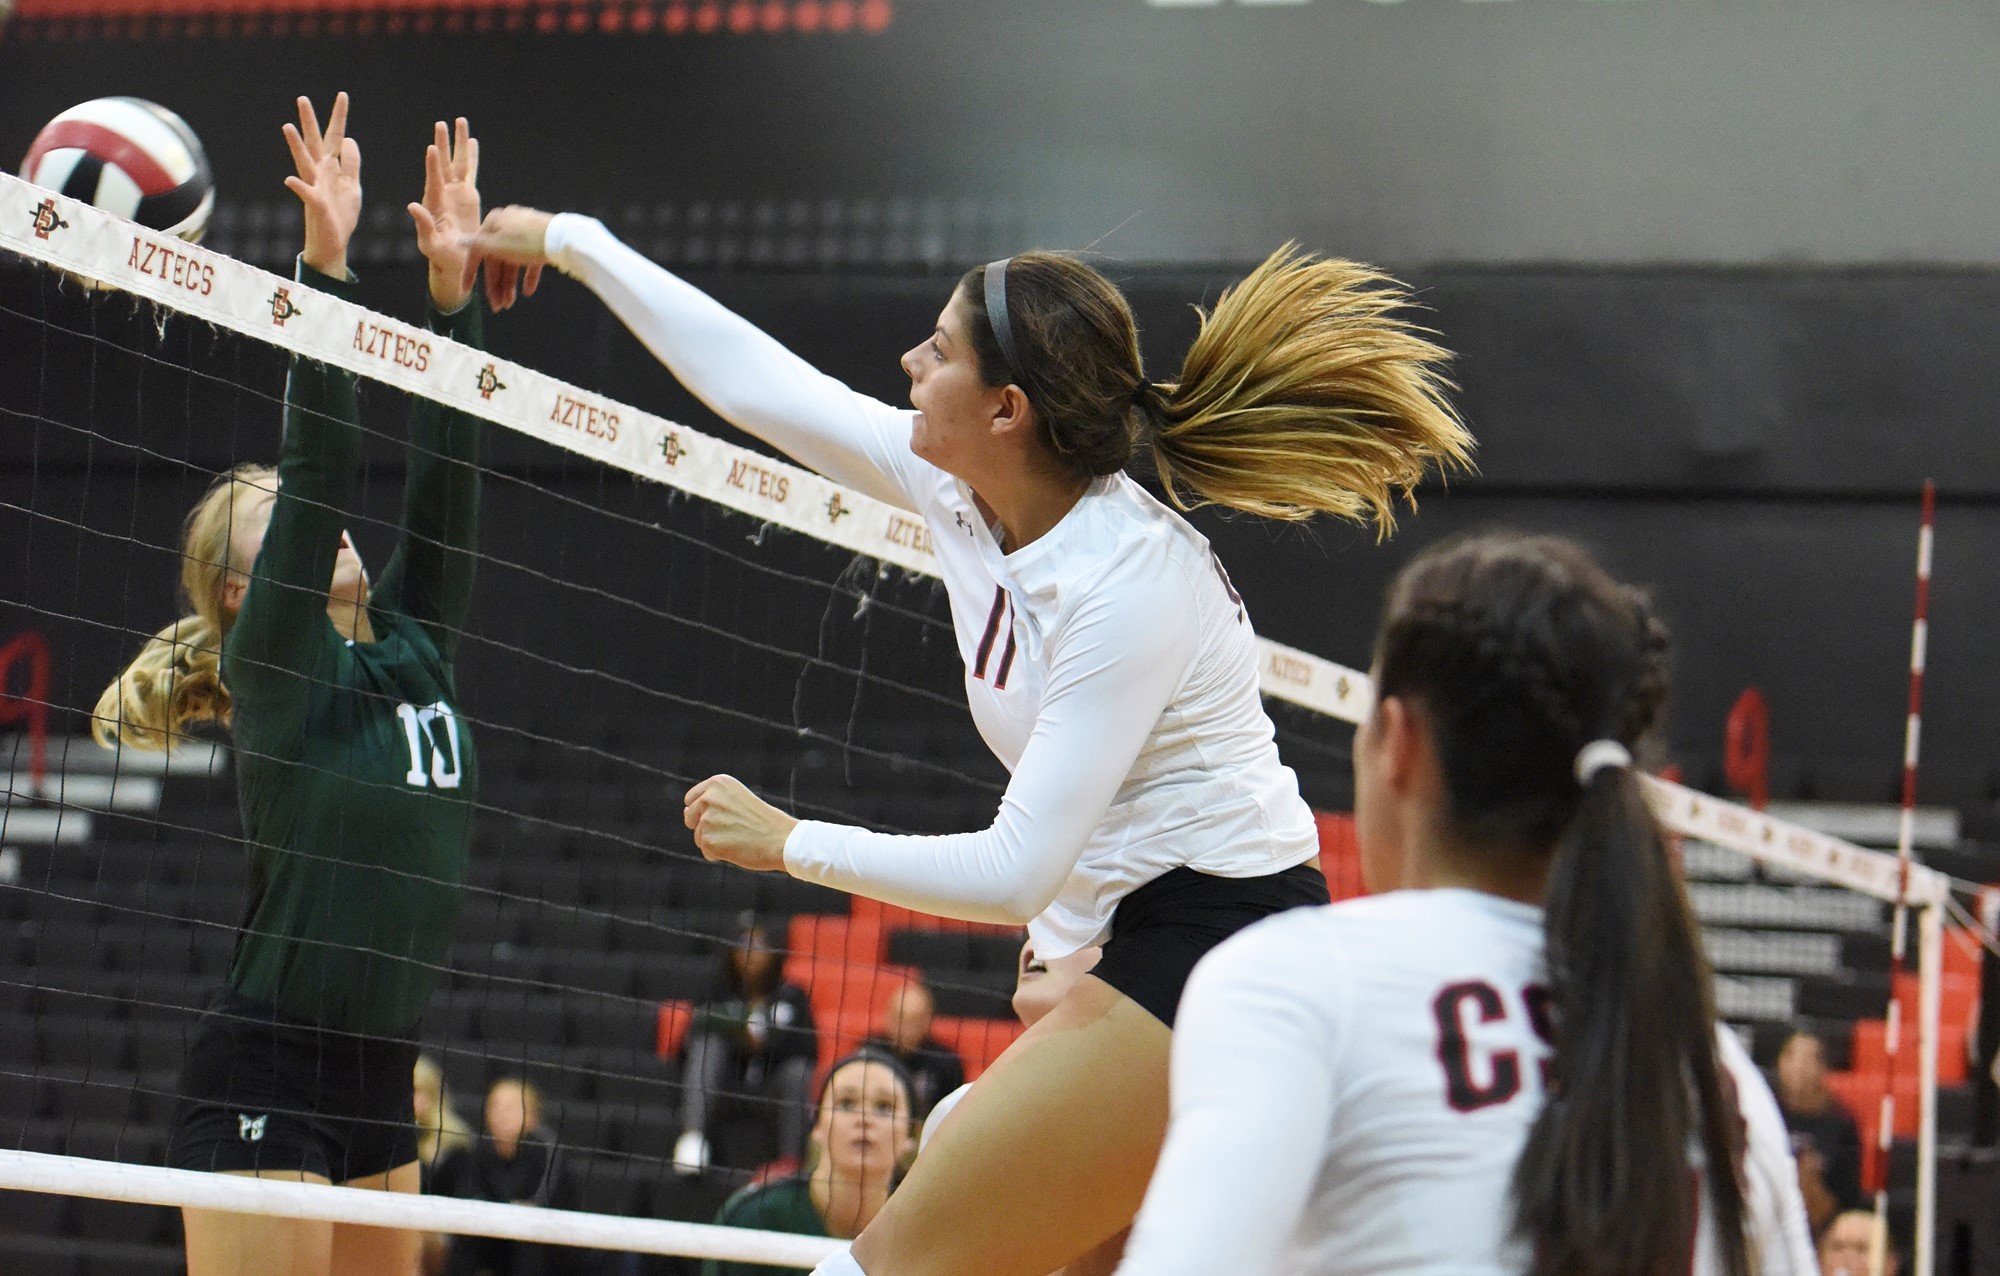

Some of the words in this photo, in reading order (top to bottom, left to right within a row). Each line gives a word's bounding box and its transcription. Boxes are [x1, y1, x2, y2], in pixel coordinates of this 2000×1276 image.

[128, 237, 215, 296] AZTECS
[353, 320, 432, 373] AZTECS
[551, 394, 620, 442] AZTECS
[727, 459, 790, 504] AZTECS
[973, 583, 1017, 690] 11
[396, 701, 461, 787] 10
